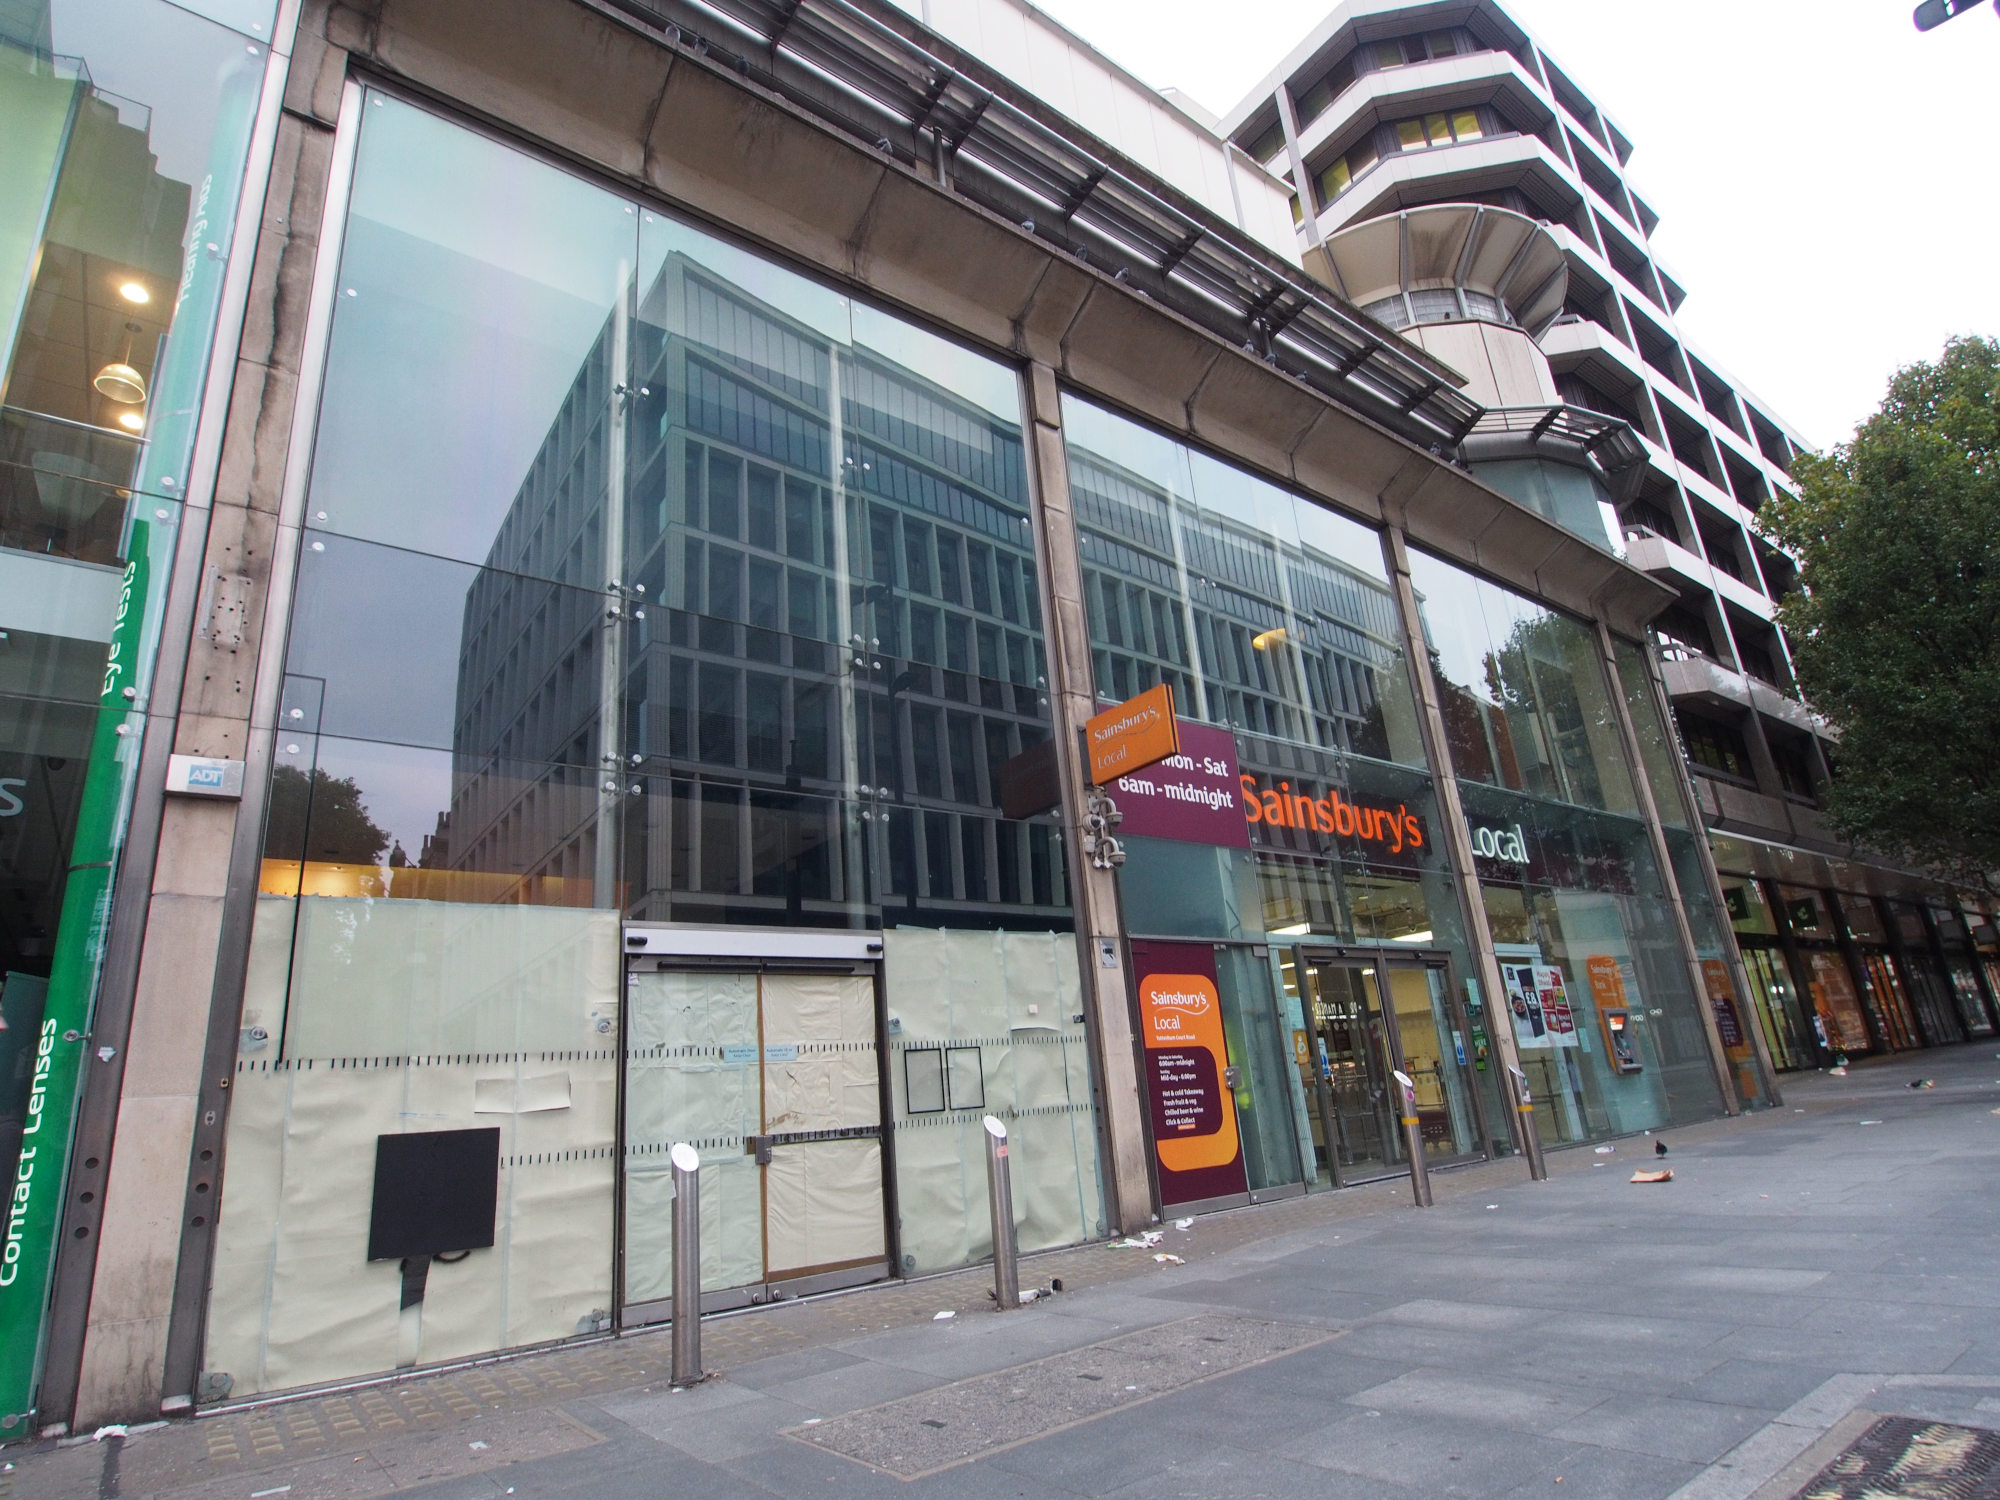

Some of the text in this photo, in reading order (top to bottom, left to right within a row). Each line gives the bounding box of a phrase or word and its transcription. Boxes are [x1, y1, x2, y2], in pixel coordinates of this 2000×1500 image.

[101, 641, 123, 697] Eye
[1094, 704, 1157, 743] Sainsbury's
[1097, 744, 1127, 769] Local
[1161, 754, 1194, 771] Mon
[1203, 757, 1229, 777] Sat
[189, 769, 222, 784] ADT
[1118, 776, 1155, 796] 6am
[1164, 782, 1234, 810] midnight
[1240, 773, 1531, 865] Sainsbury's Local
[1151, 991, 1207, 1007] Sainsbury's
[1154, 1015, 1180, 1030] Local
[0, 1017, 57, 1287] Contact Lenses
